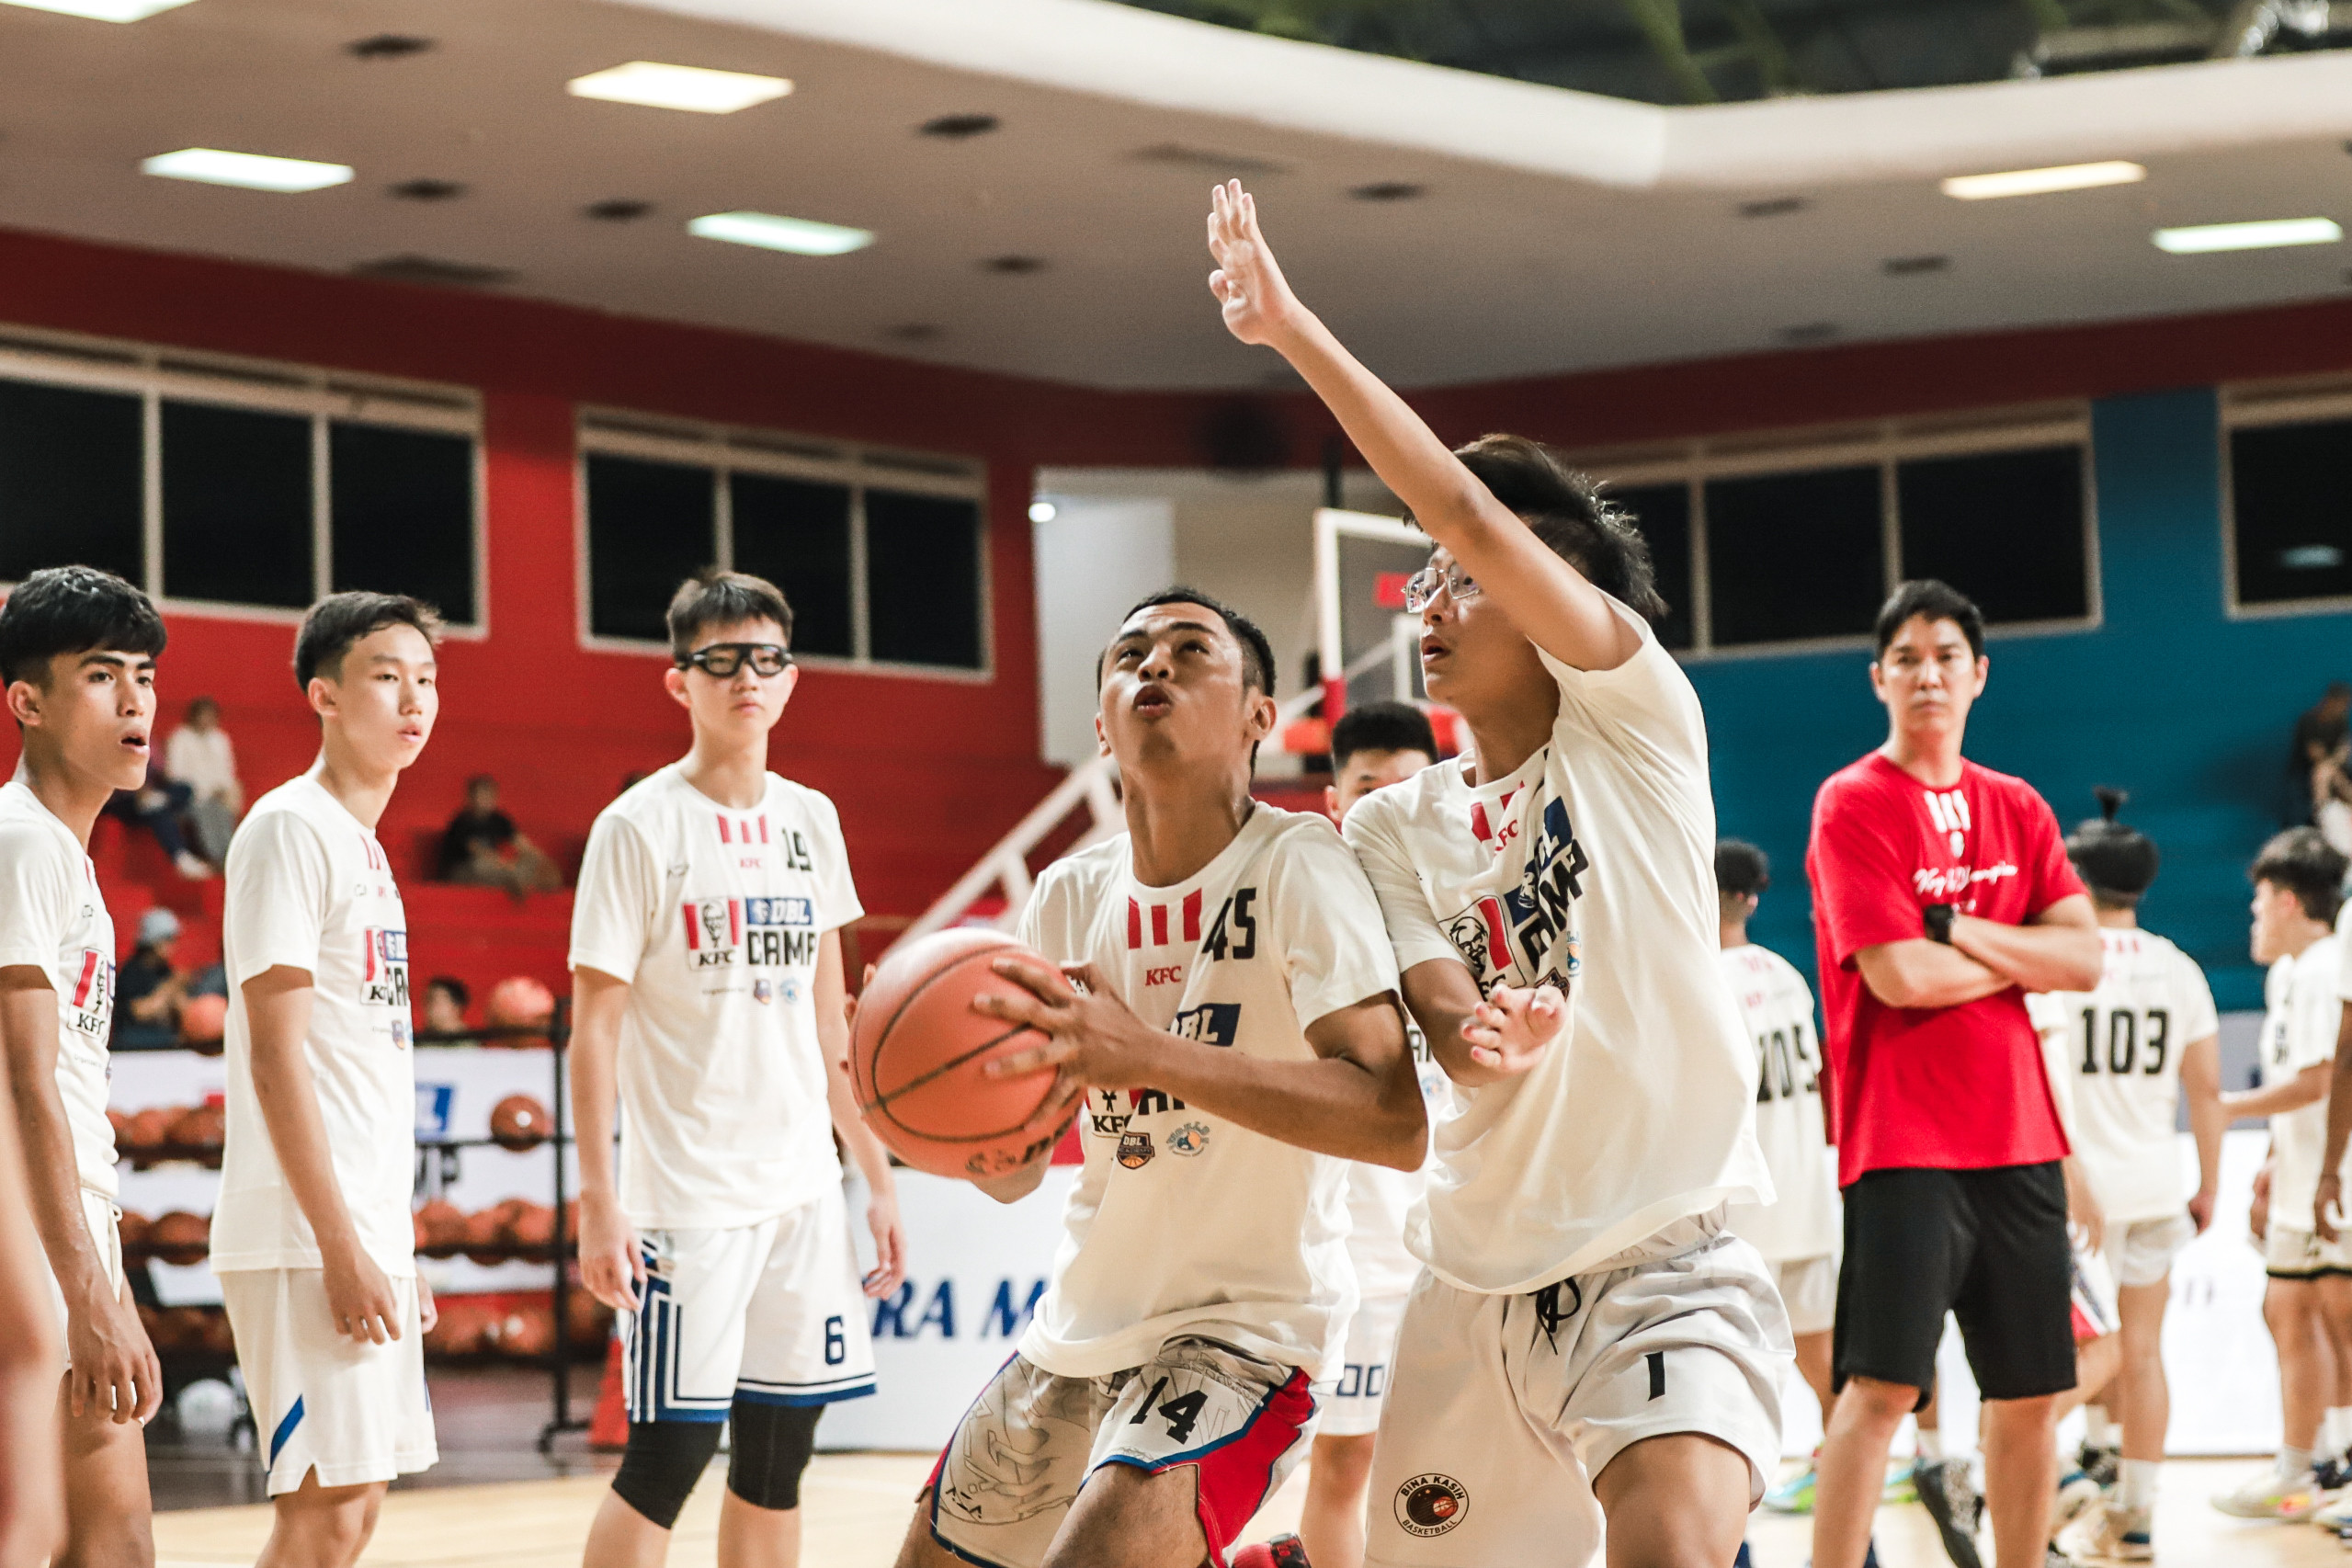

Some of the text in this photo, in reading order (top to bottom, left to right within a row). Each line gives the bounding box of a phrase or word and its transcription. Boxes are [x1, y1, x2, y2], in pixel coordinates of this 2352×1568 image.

[781, 826, 812, 871] 19
[771, 898, 811, 924] DBL
[1201, 887, 1257, 962] 45
[699, 948, 736, 967] KFC
[1144, 965, 1183, 987] KFC
[2081, 1007, 2168, 1074] 103
[824, 1315, 845, 1366] 6
[1129, 1375, 1209, 1446] 14
[1400, 1475, 1466, 1500] BINA KASIH
[1402, 1518, 1458, 1536] BASKETBALL
